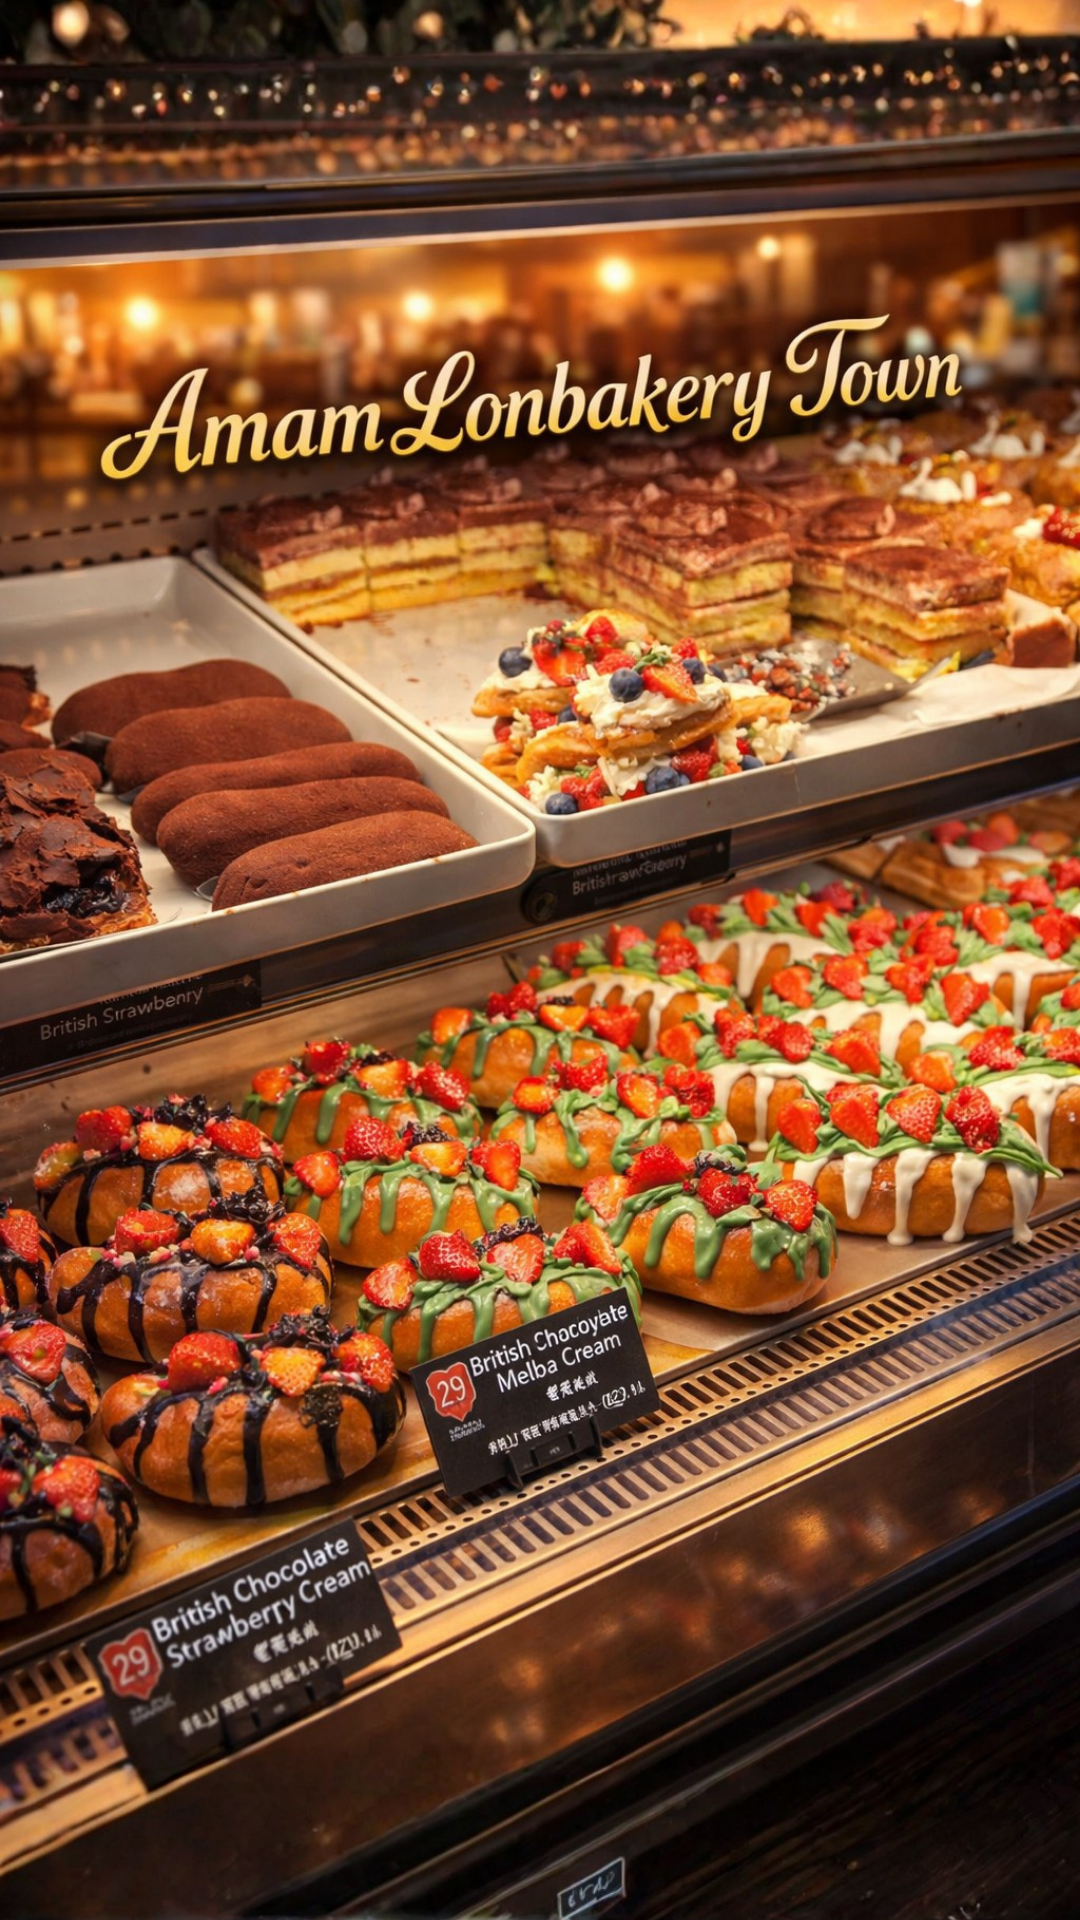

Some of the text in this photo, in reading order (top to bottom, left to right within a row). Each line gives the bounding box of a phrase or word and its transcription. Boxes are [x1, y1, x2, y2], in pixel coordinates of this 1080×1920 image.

[100, 313, 963, 479] Amam Lonbakery Town
[40, 1012, 98, 1041] British
[469, 1338, 532, 1377] British
[497, 1358, 559, 1393] Melba
[561, 1333, 622, 1367] Cream
[436, 1375, 467, 1409] 29
[151, 1591, 232, 1643] British
[233, 1537, 350, 1603] Chocolate
[166, 1595, 296, 1669] Strawberry
[298, 1560, 372, 1604] Cream
[112, 1645, 150, 1687] 29
